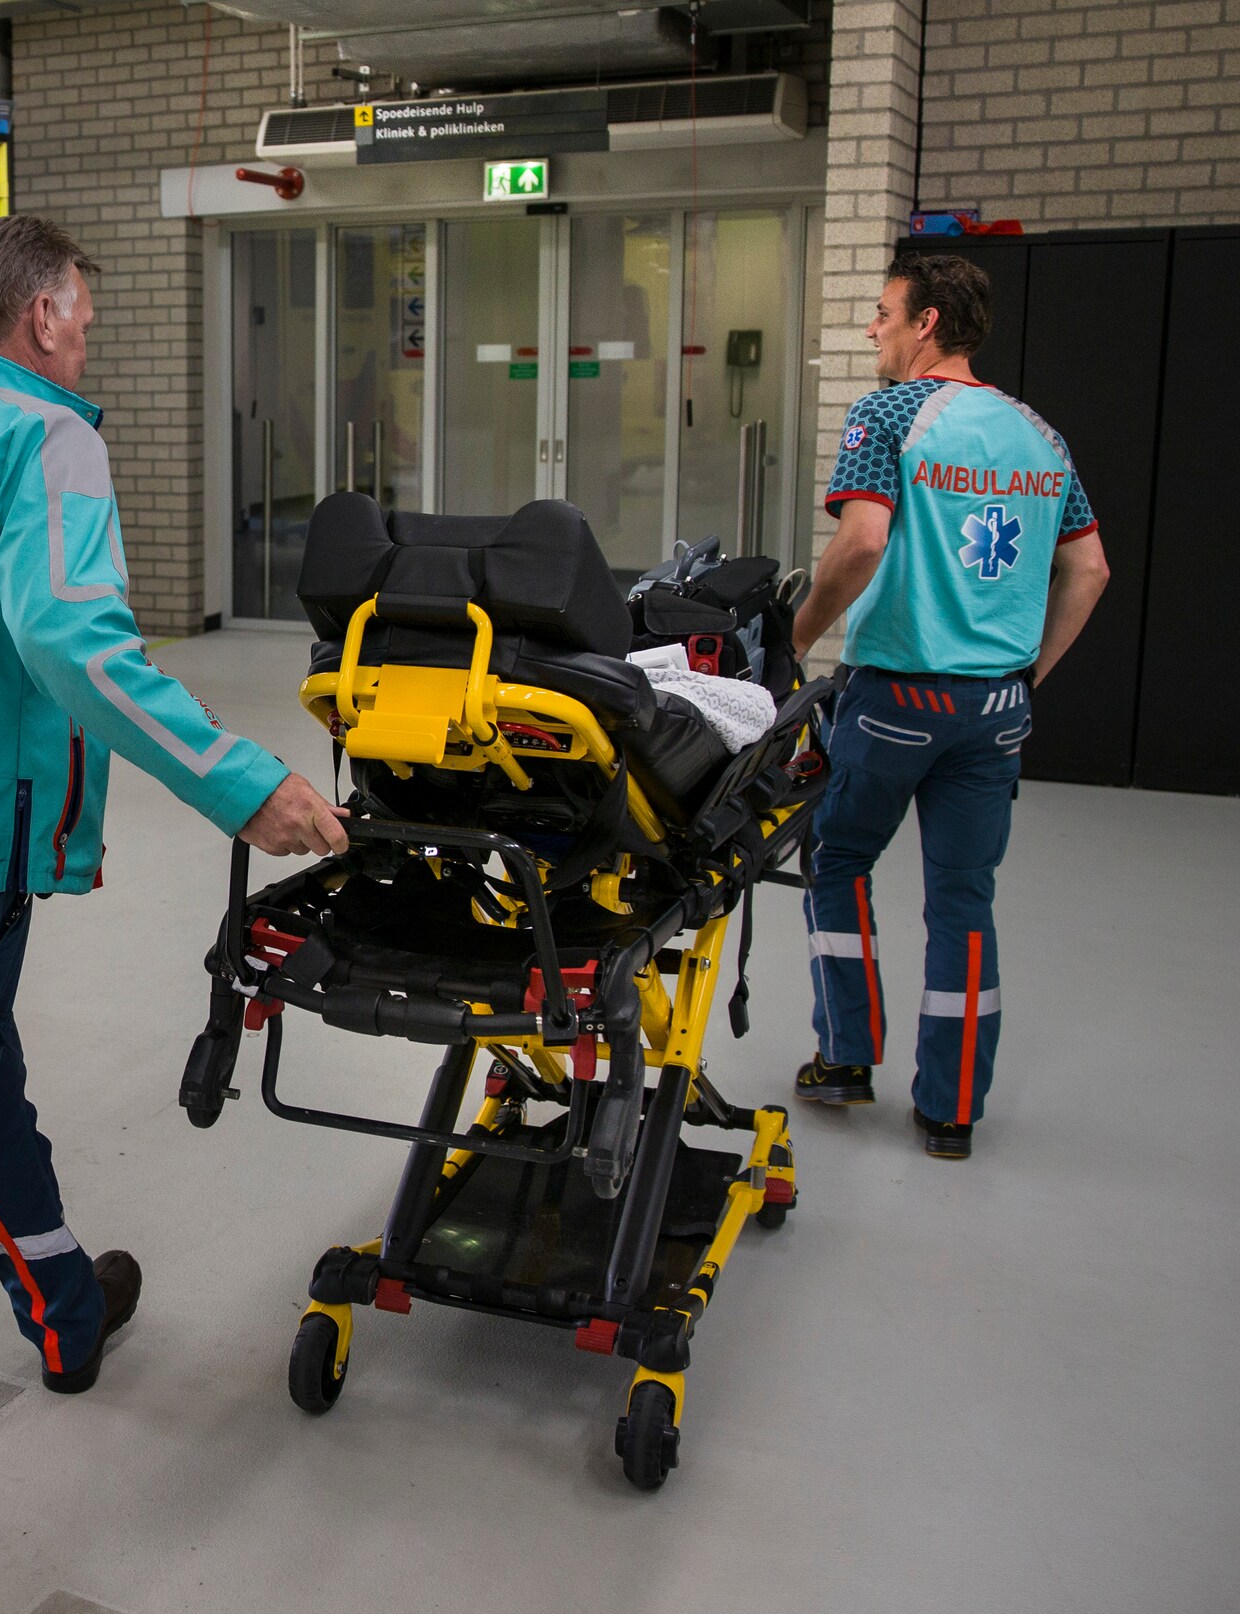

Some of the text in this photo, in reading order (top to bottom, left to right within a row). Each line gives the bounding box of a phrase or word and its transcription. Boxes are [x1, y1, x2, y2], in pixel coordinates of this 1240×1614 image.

[376, 102, 485, 121] Spoedeisende Hulp
[375, 121, 504, 139] Kliniek & poliklinieken
[911, 460, 1065, 498] AMBULANCE
